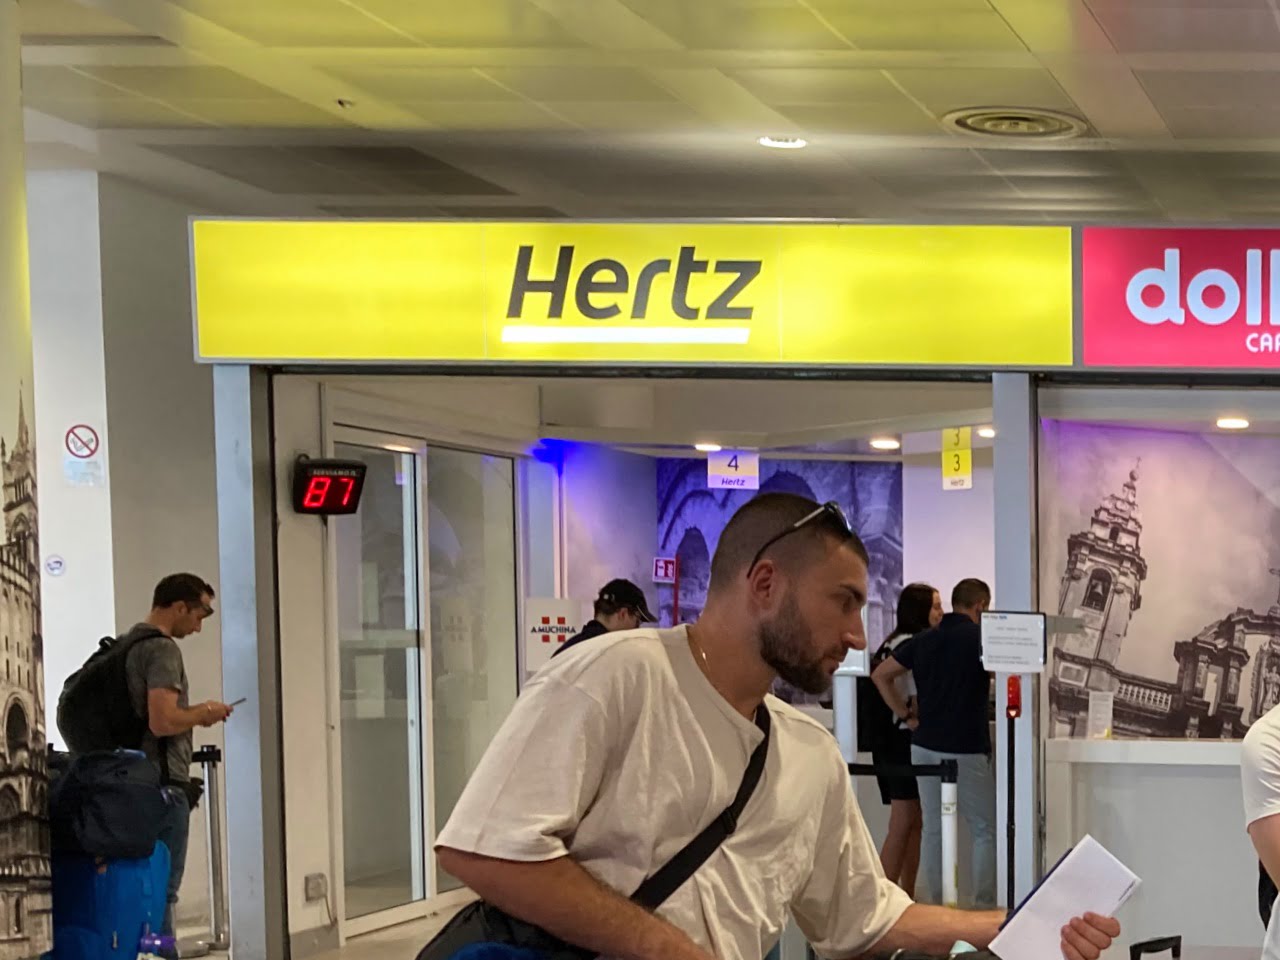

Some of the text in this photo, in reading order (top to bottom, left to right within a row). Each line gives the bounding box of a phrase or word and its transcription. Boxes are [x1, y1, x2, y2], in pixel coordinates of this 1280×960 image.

[506, 245, 762, 320] Hertz
[727, 454, 739, 471] 4
[953, 453, 960, 472] 3
[721, 477, 746, 486] Hertz
[303, 477, 355, 508] 87
[531, 626, 576, 634] AMUCHINA
